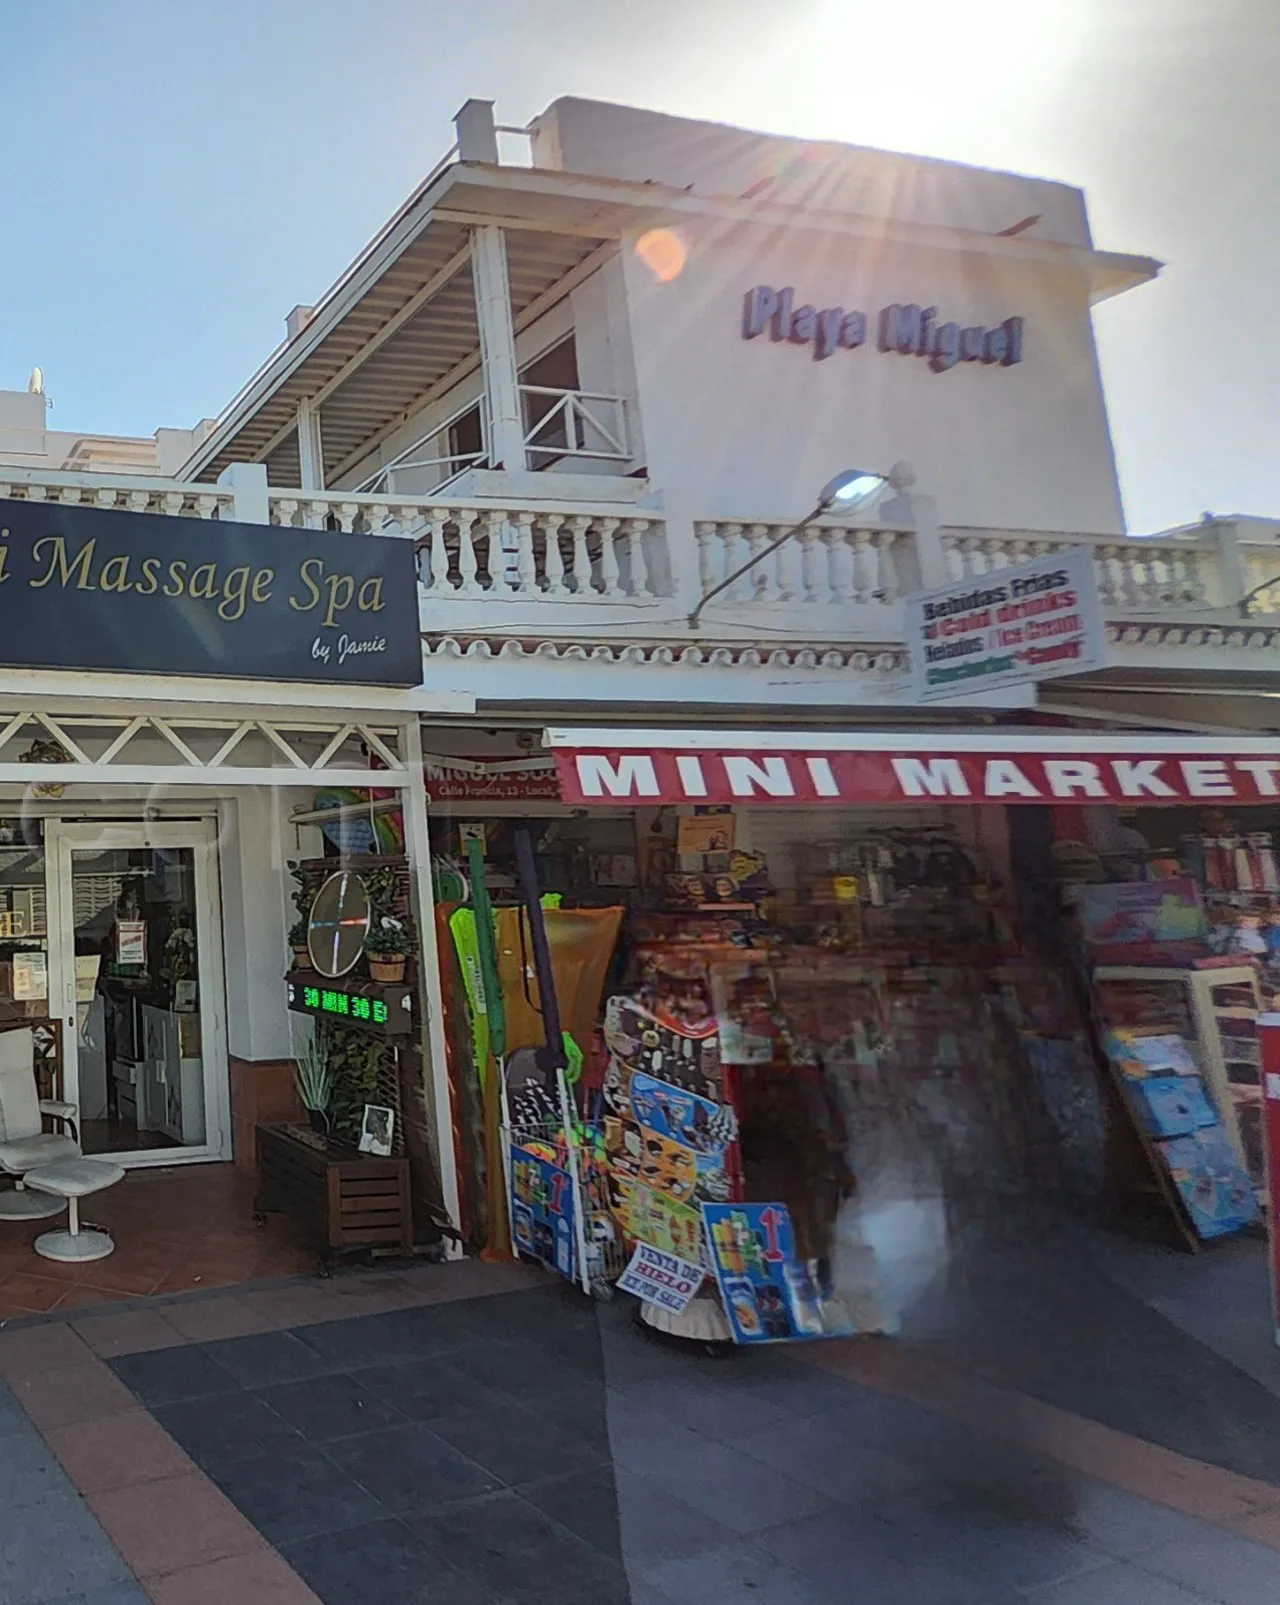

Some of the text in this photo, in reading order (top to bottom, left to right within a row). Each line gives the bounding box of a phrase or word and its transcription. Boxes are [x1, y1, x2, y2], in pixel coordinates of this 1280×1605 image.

[742, 284, 1023, 373] Playa Miguel
[29, 536, 275, 621] Massage
[288, 558, 387, 627] Spa
[311, 634, 387, 664] by Jamie
[438, 786, 463, 795] Calle
[575, 756, 1280, 797] MINI MARKET
[634, 1261, 692, 1294] HIELO
[639, 1245, 703, 1284] VENTA DE
